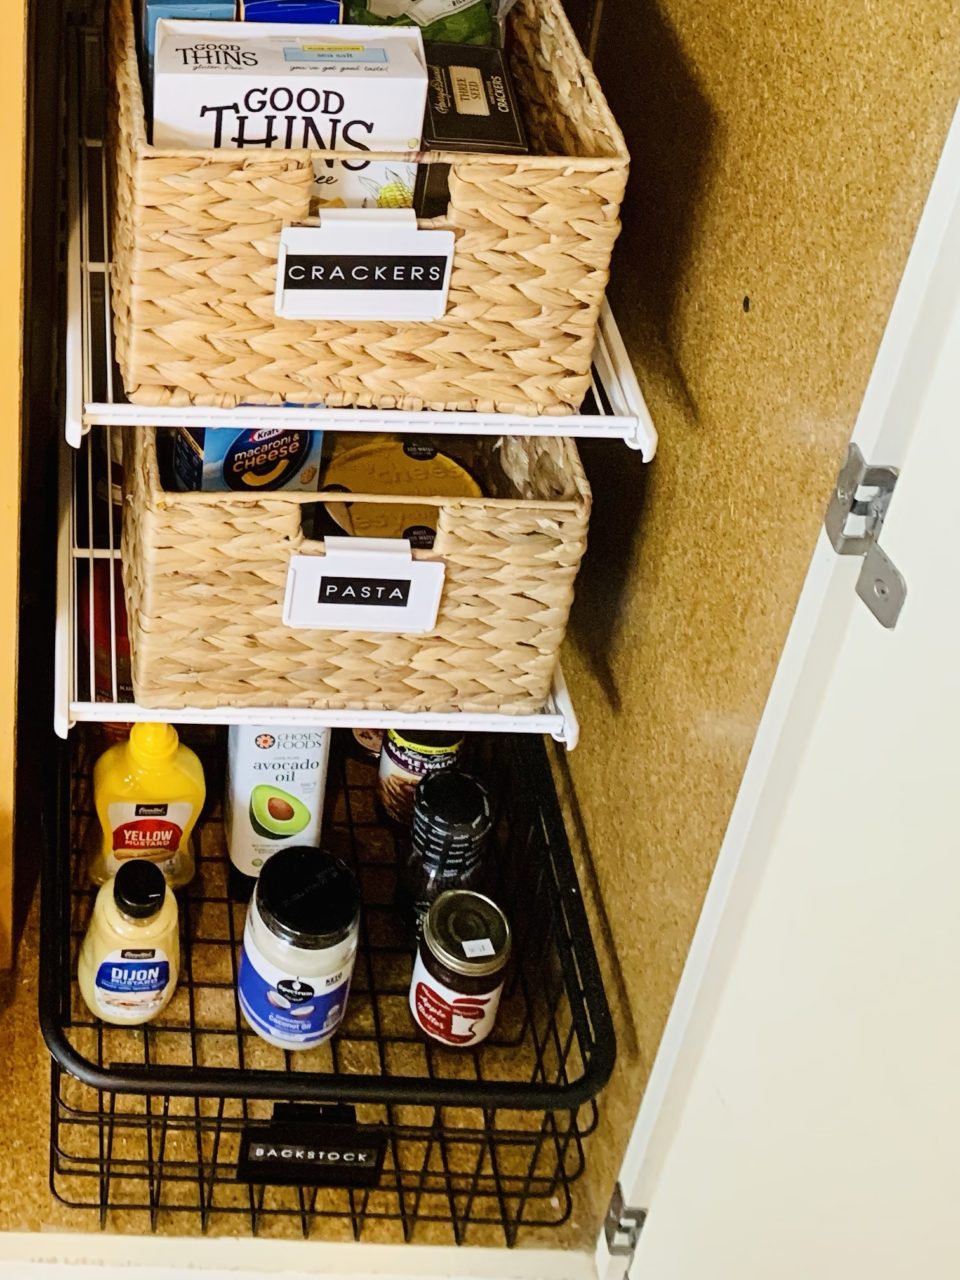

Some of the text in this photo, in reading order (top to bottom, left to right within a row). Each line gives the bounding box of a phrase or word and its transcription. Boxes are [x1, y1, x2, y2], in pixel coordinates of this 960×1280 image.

[194, 43, 241, 52] GOOD
[175, 47, 259, 67] THINS
[455, 77, 470, 102] THREE
[468, 81, 481, 100] SEED
[491, 75, 510, 113] CRACKERS
[244, 87, 345, 115] GOOD
[200, 103, 375, 171] THINS
[288, 266, 441, 281] CRACKERS
[234, 433, 300, 462] macaroni &
[325, 583, 404, 600] PASTA
[277, 732, 323, 741] CHOSEN
[277, 740, 323, 750] FOODS
[253, 758, 320, 770] avocado
[275, 771, 296, 782] oil
[123, 829, 173, 841] YELLOW
[124, 838, 170, 847] MUSTARD
[111, 966, 159, 981] DIJON
[255, 1147, 368, 1162] BACKSTOCK
